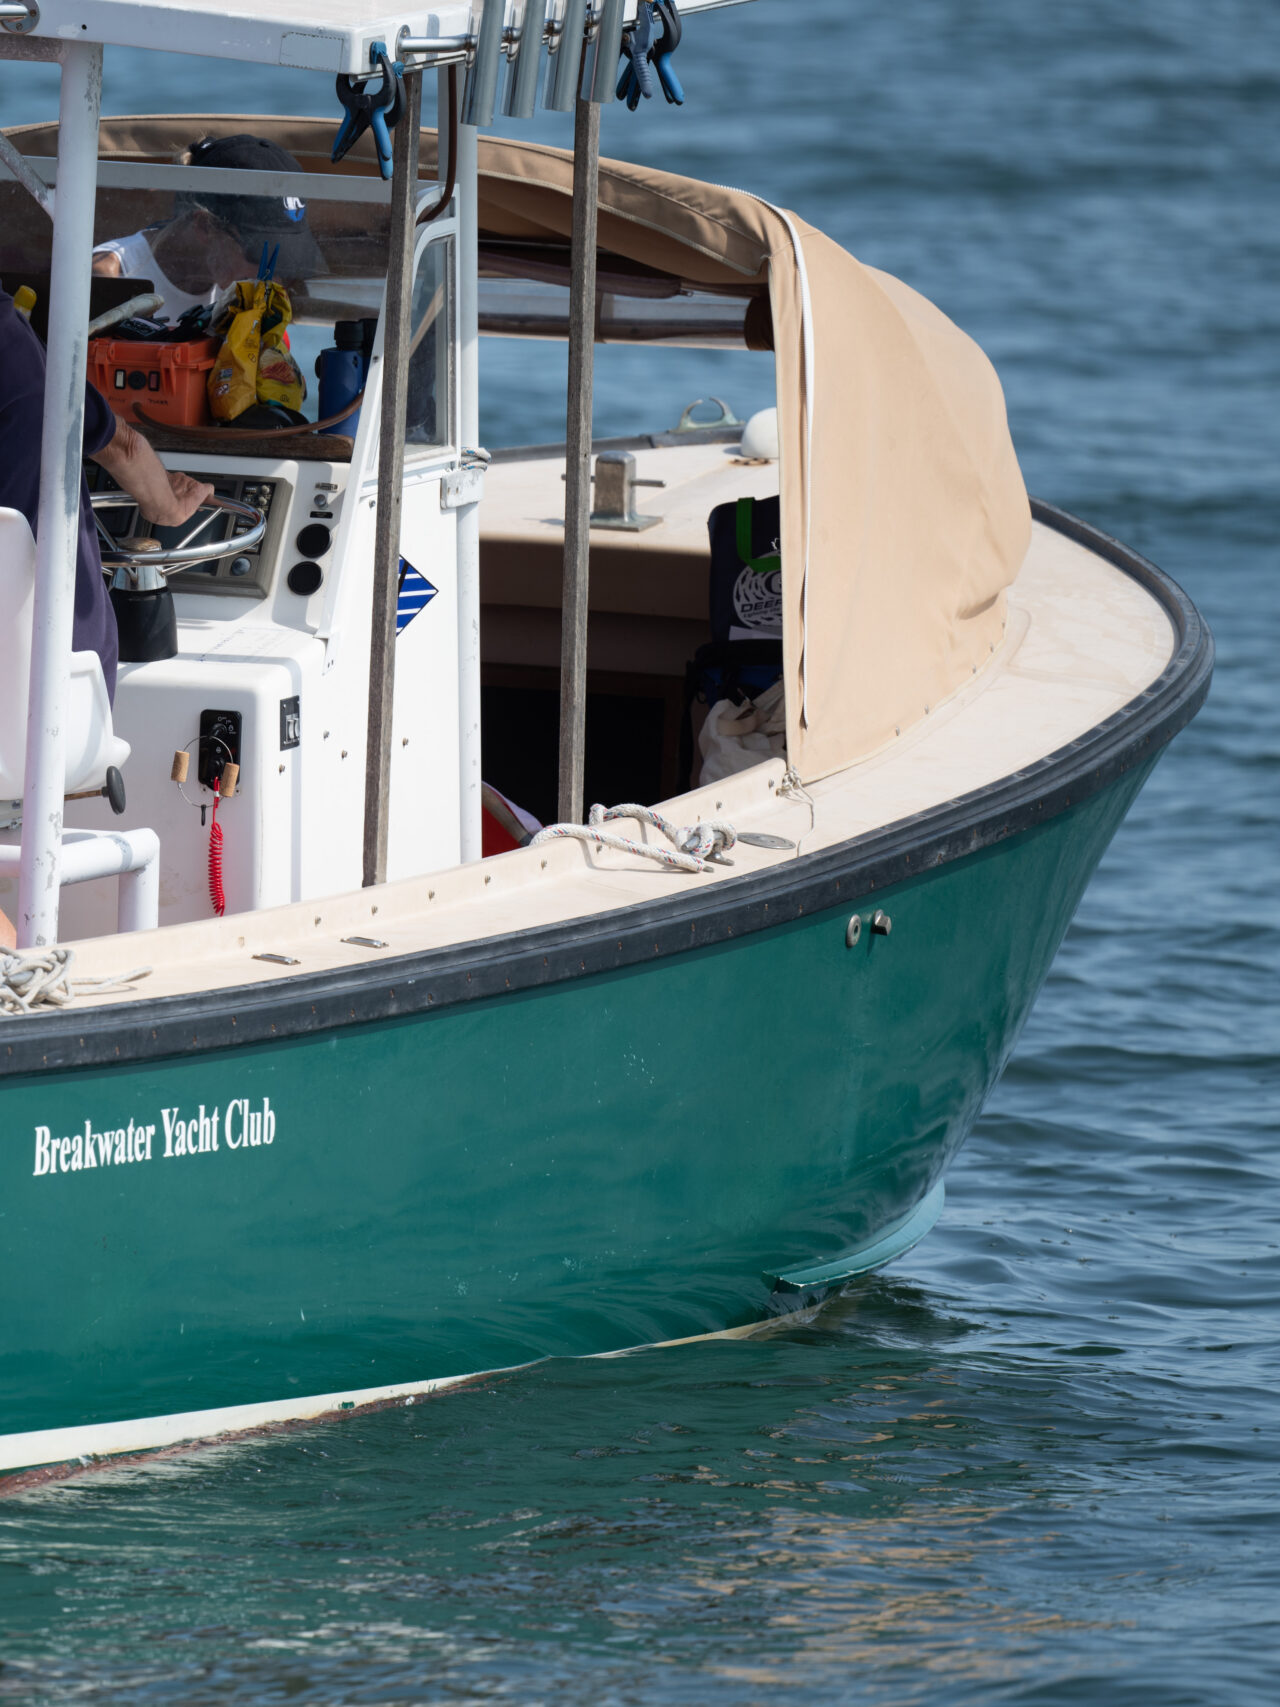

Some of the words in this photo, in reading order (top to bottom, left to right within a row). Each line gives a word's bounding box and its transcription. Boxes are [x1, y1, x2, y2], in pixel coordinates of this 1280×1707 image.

[32, 1118, 156, 1176] Breakwater
[161, 1104, 220, 1158] Yacht
[224, 1097, 276, 1150] Club
